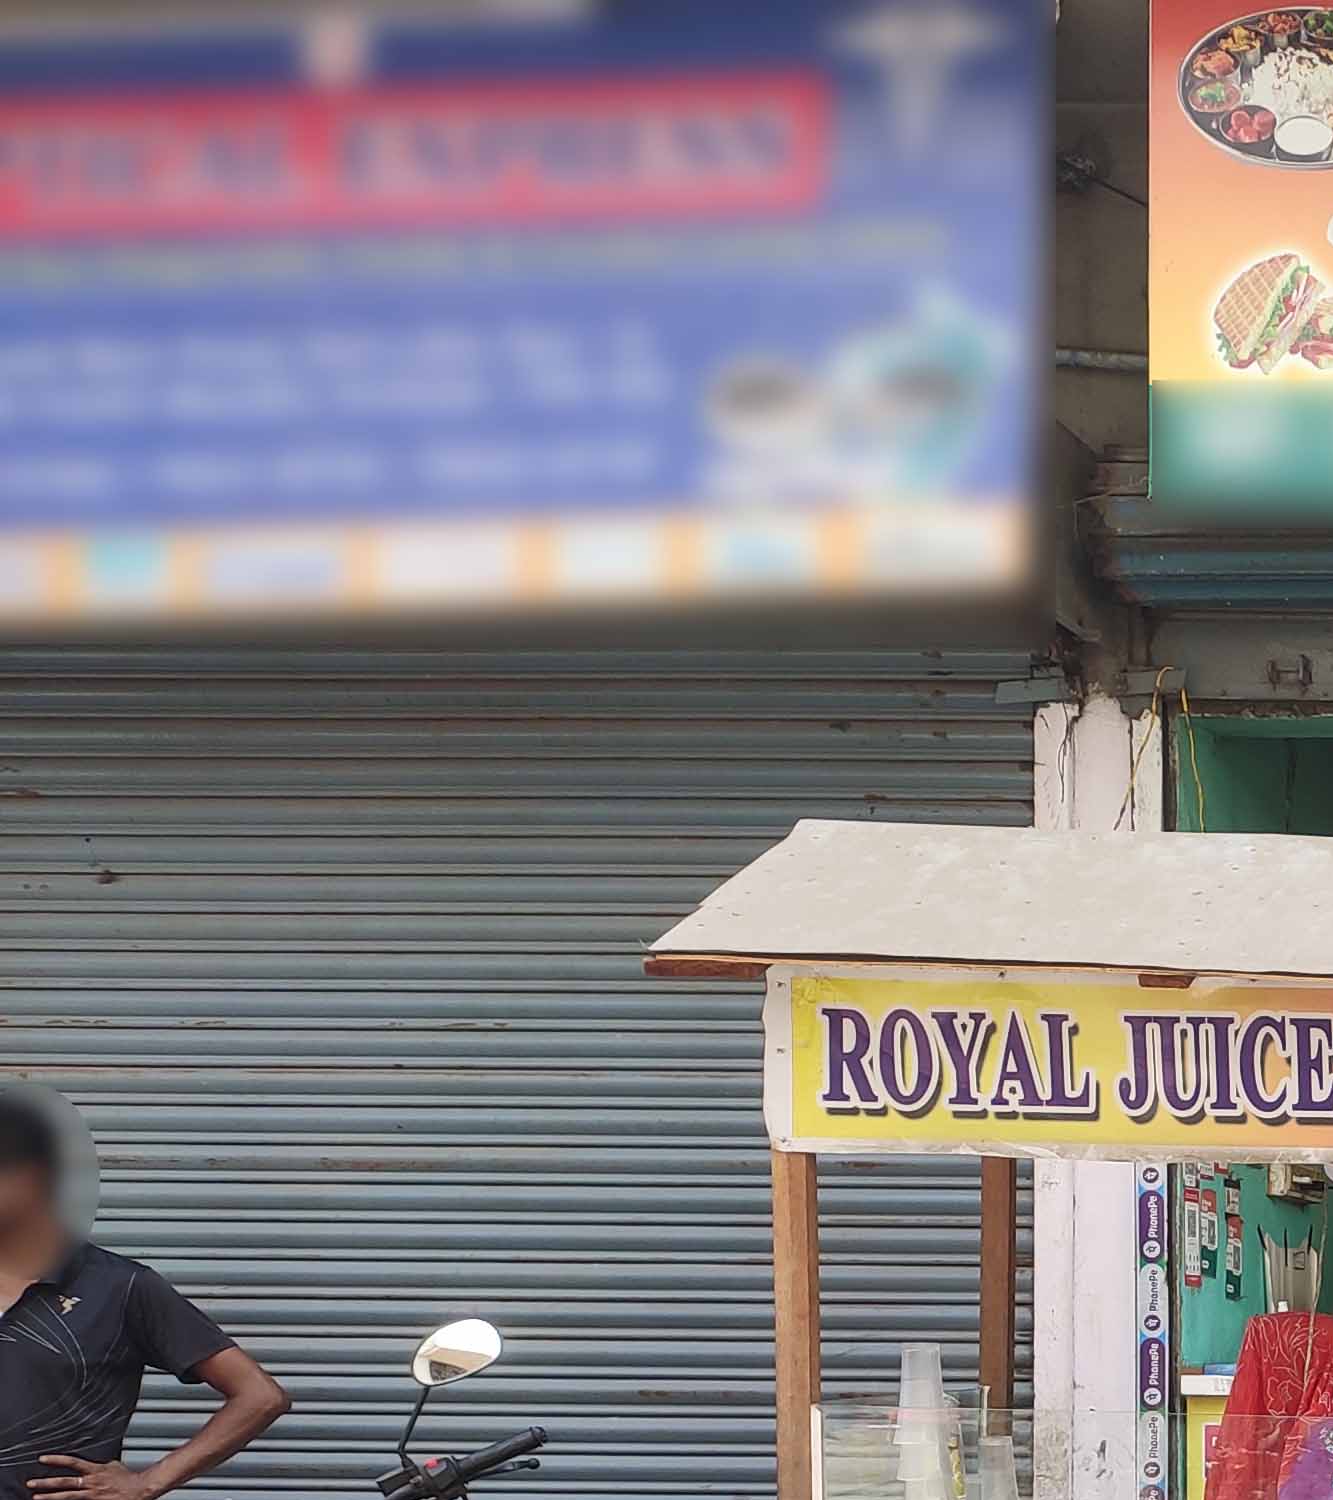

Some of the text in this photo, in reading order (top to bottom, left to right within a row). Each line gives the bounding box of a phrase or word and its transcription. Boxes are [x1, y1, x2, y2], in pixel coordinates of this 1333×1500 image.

[820, 1006, 1094, 1108] ROYAL
[1147, 1194, 1159, 1239] PhonePe
[1149, 1268, 1160, 1312] PhonePe
[1148, 1343, 1160, 1386] PhonePe
[1148, 1414, 1159, 1459] PhonePe
